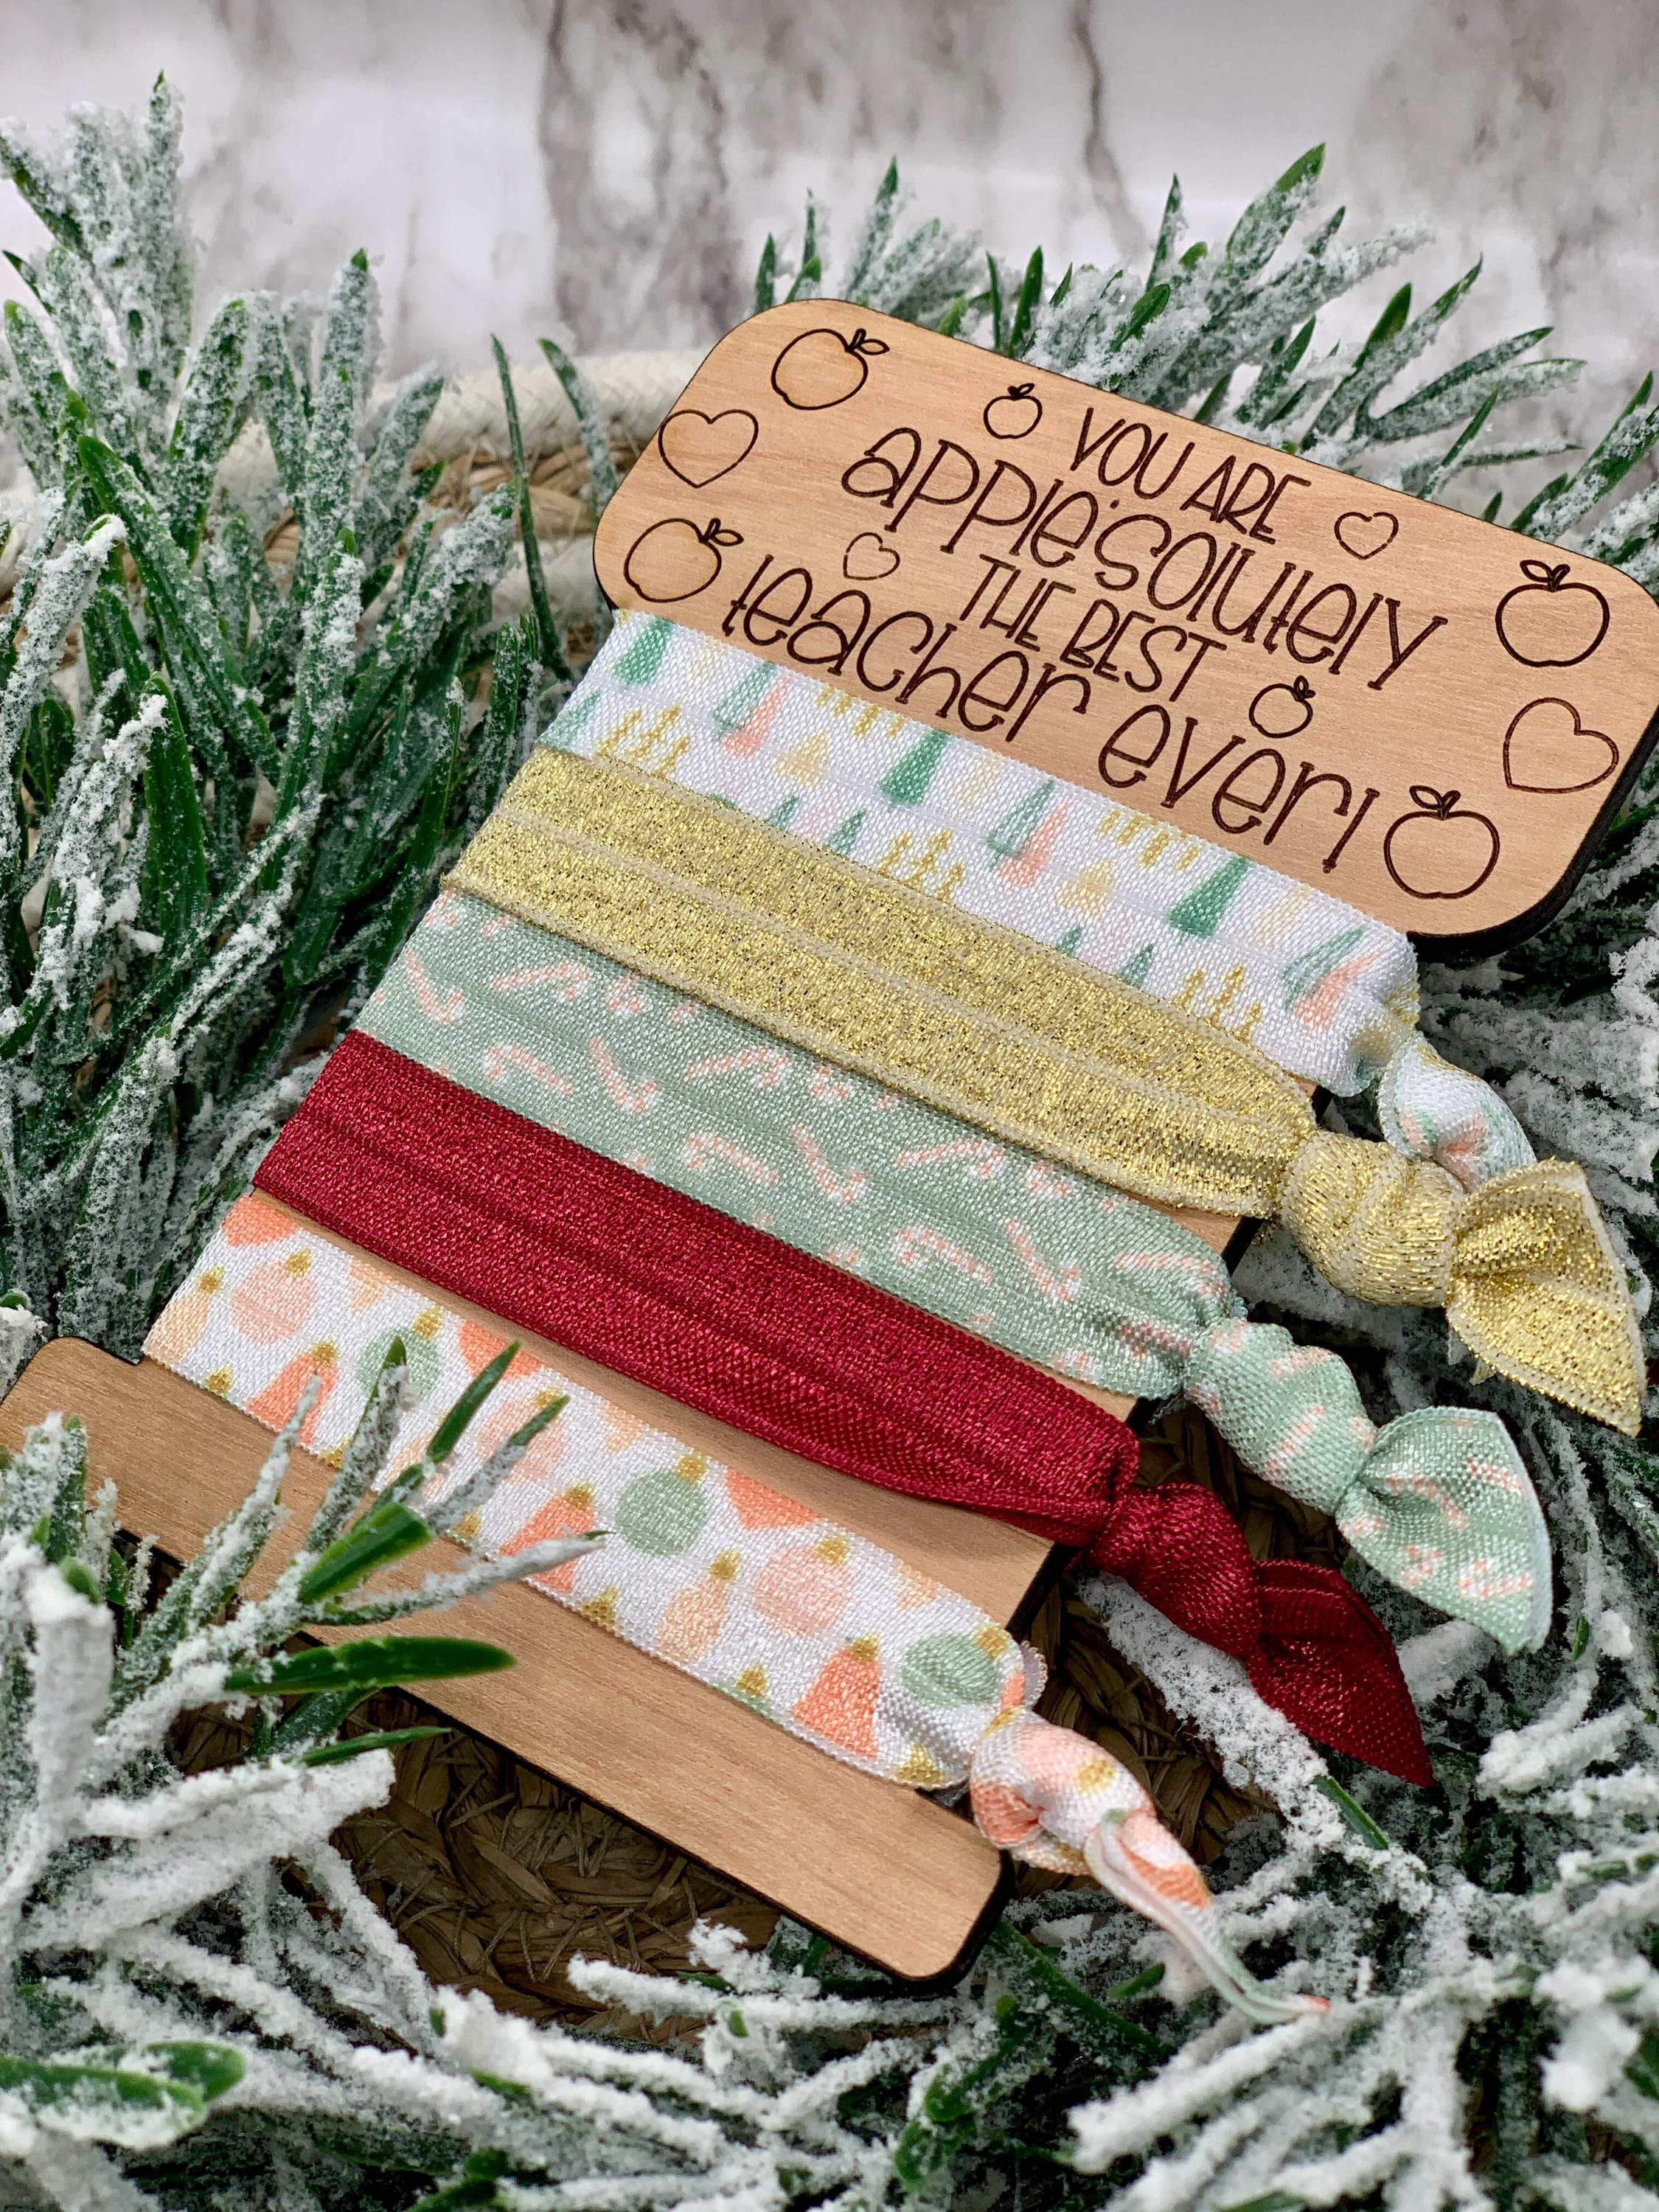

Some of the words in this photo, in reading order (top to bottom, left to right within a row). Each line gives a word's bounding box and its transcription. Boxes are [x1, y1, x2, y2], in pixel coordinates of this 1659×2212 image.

[1070, 407, 1195, 499] YOU
[1180, 455, 1312, 545] ARE
[959, 554, 1077, 652] THE
[1060, 599, 1227, 702] BEST
[722, 554, 1091, 742] teacher
[1099, 704, 1380, 874] ever!
